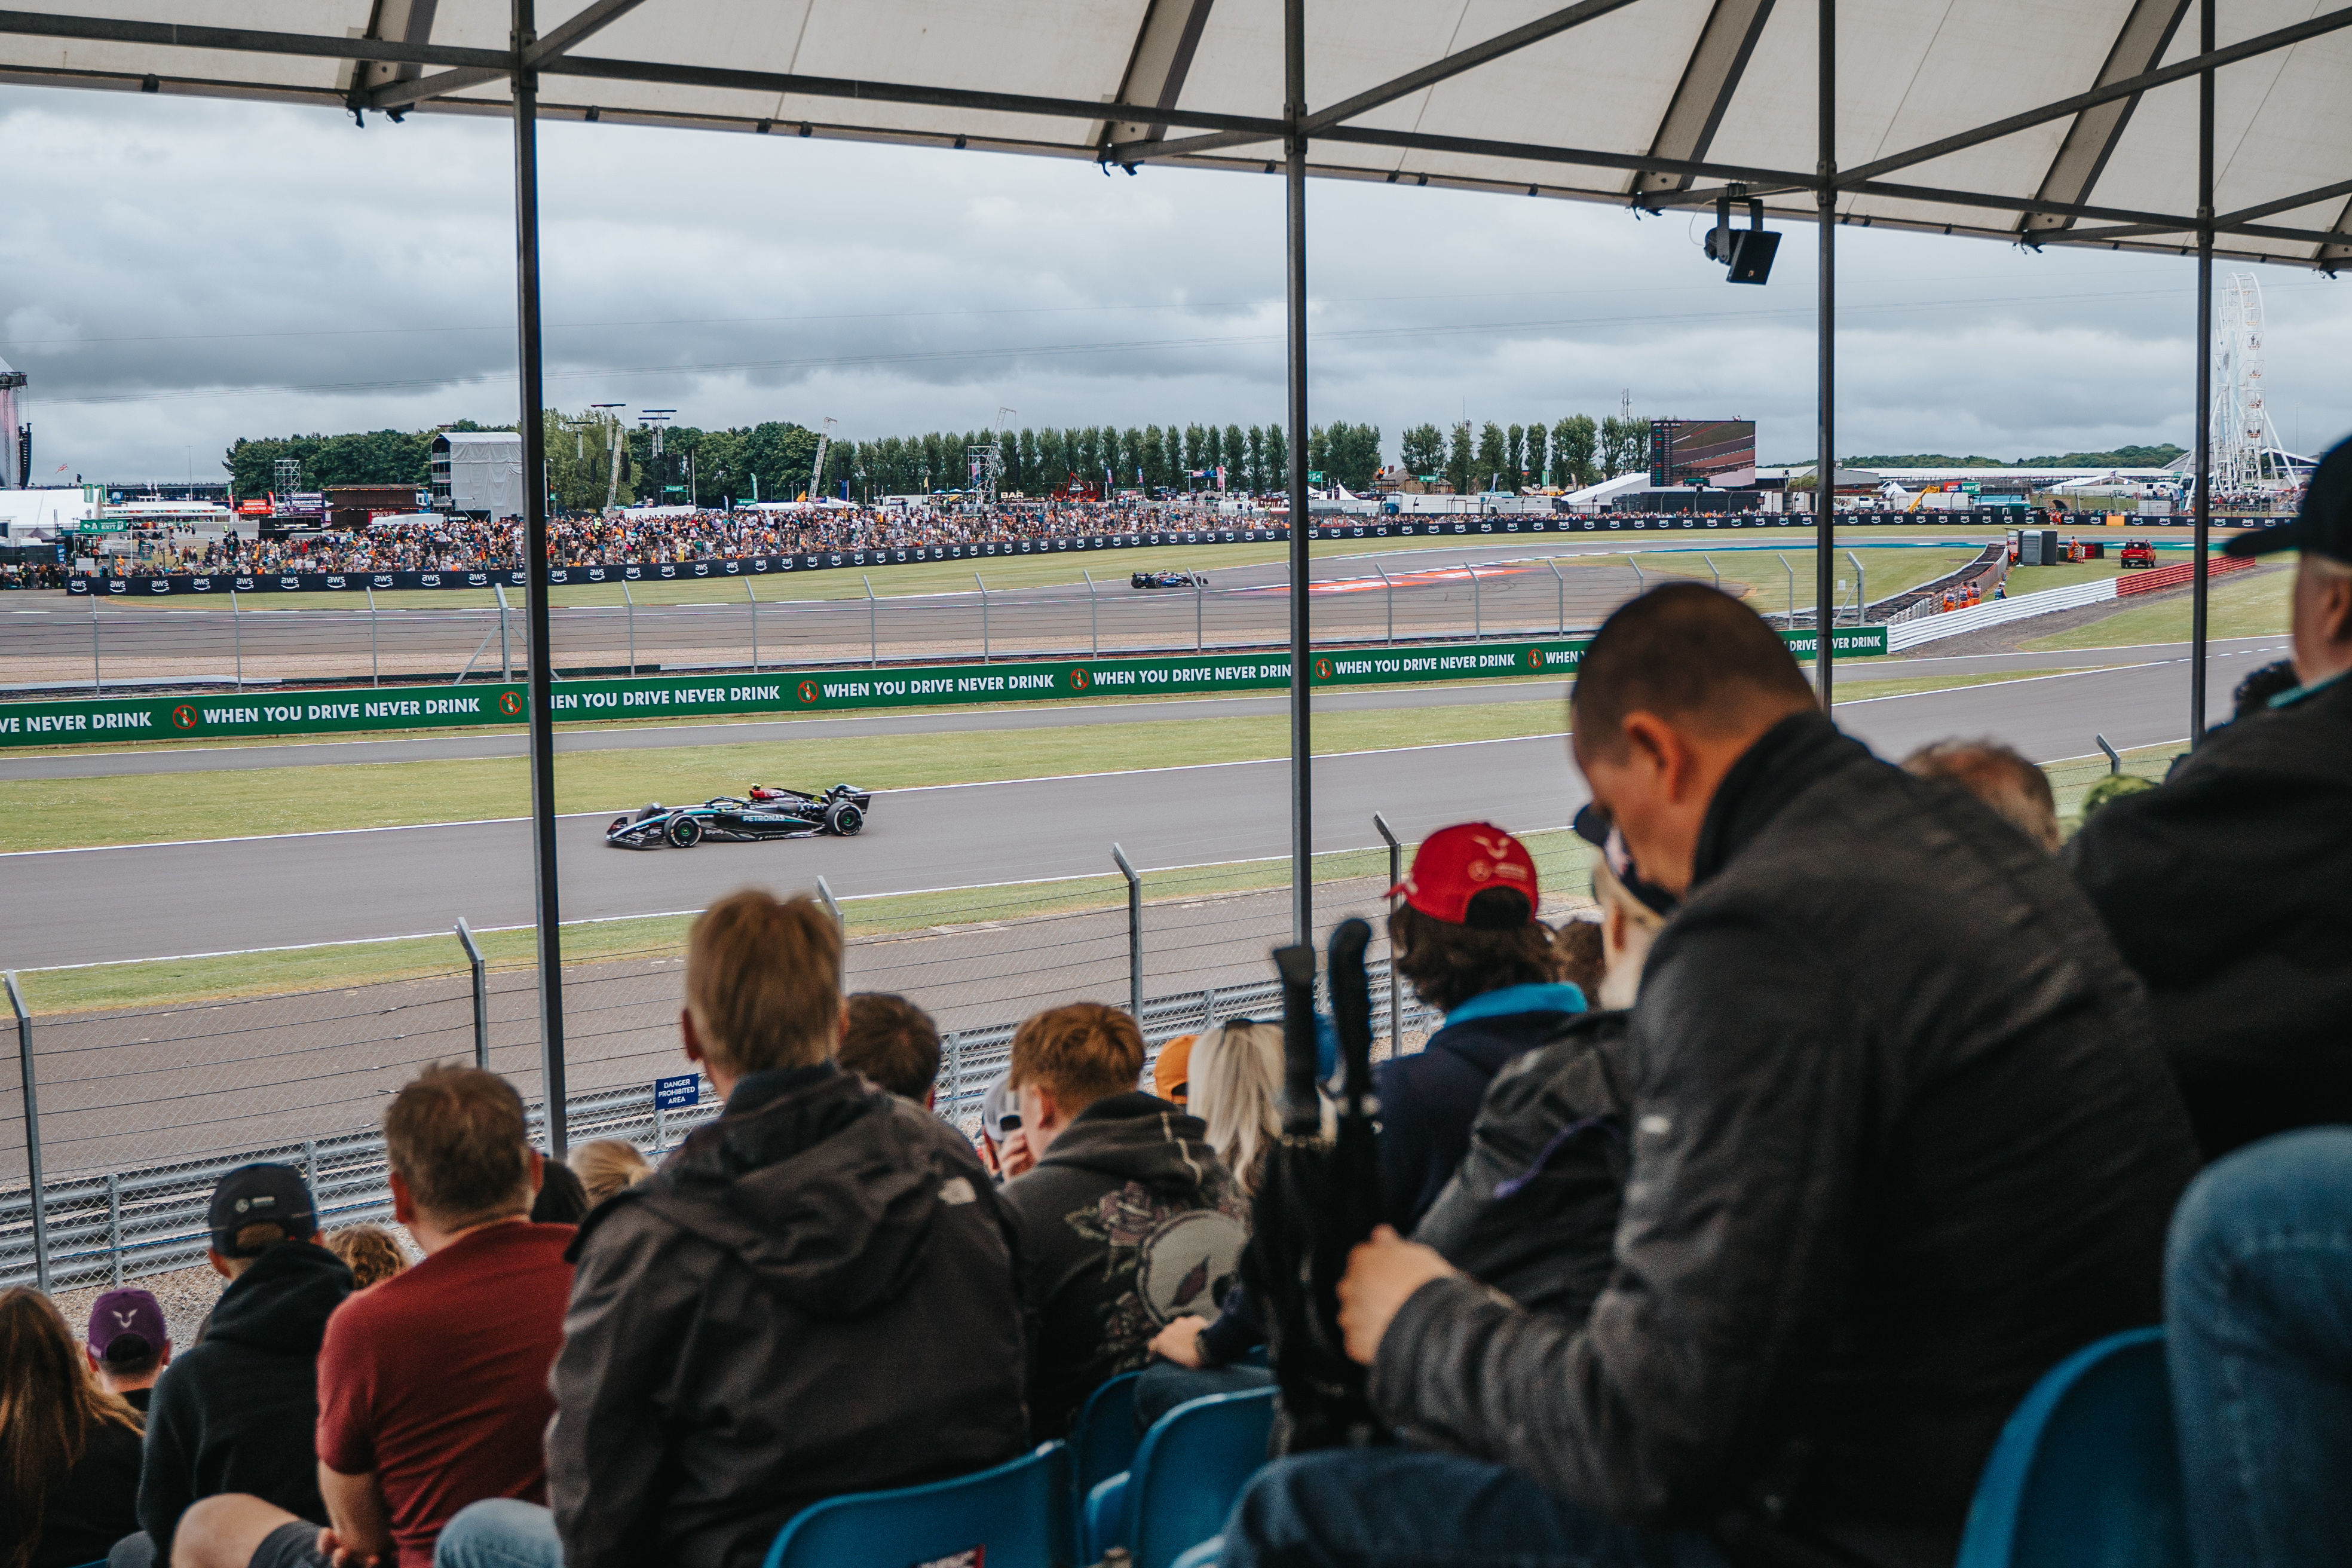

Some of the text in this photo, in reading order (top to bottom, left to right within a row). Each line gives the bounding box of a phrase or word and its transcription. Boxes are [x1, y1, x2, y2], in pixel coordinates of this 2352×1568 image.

[1790, 639, 1817, 652] DRIVE
[1851, 635, 1881, 648] DRINK
[1335, 653, 1515, 675] WHEN YOU DRIVE NEVER DRINK
[1545, 651, 1578, 664] WHEN
[1093, 664, 1291, 685] WHEN YOU DRIVE NEVER DRIN
[823, 674, 1054, 697] WHEN YOU DRIVE NEVER DRINK
[582, 693, 617, 708] YOU
[623, 690, 670, 706] DRIVE
[675, 688, 725, 703] NEVER
[731, 685, 780, 701] DRINK
[203, 698, 480, 724] WHEN YOU DRIVE NEVER DRINK
[26, 715, 87, 732] NEVER
[93, 712, 152, 729] DRINK
[658, 1086, 696, 1098] PROHIBITED
[663, 1079, 691, 1089] DANGER
[667, 1096, 686, 1105] AREA
